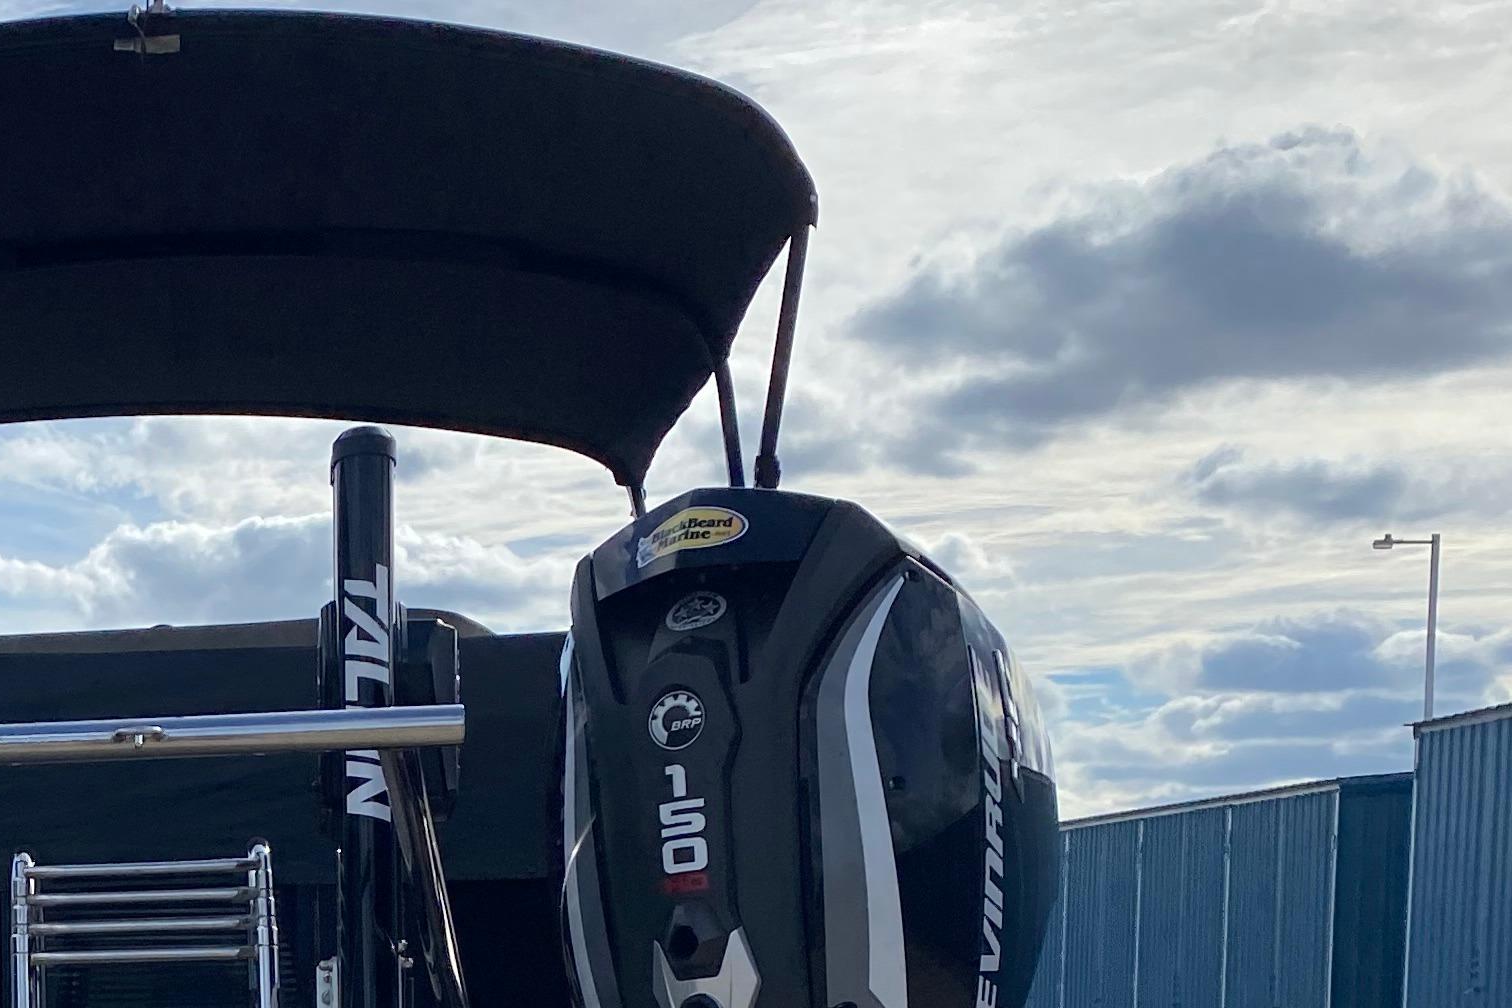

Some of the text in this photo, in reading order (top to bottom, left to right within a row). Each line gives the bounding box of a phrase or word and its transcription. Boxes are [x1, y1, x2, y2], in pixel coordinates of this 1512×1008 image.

[656, 529, 711, 552] Marine
[344, 562, 392, 822] TALN
[670, 717, 702, 731] BRP
[658, 763, 709, 875] 150
